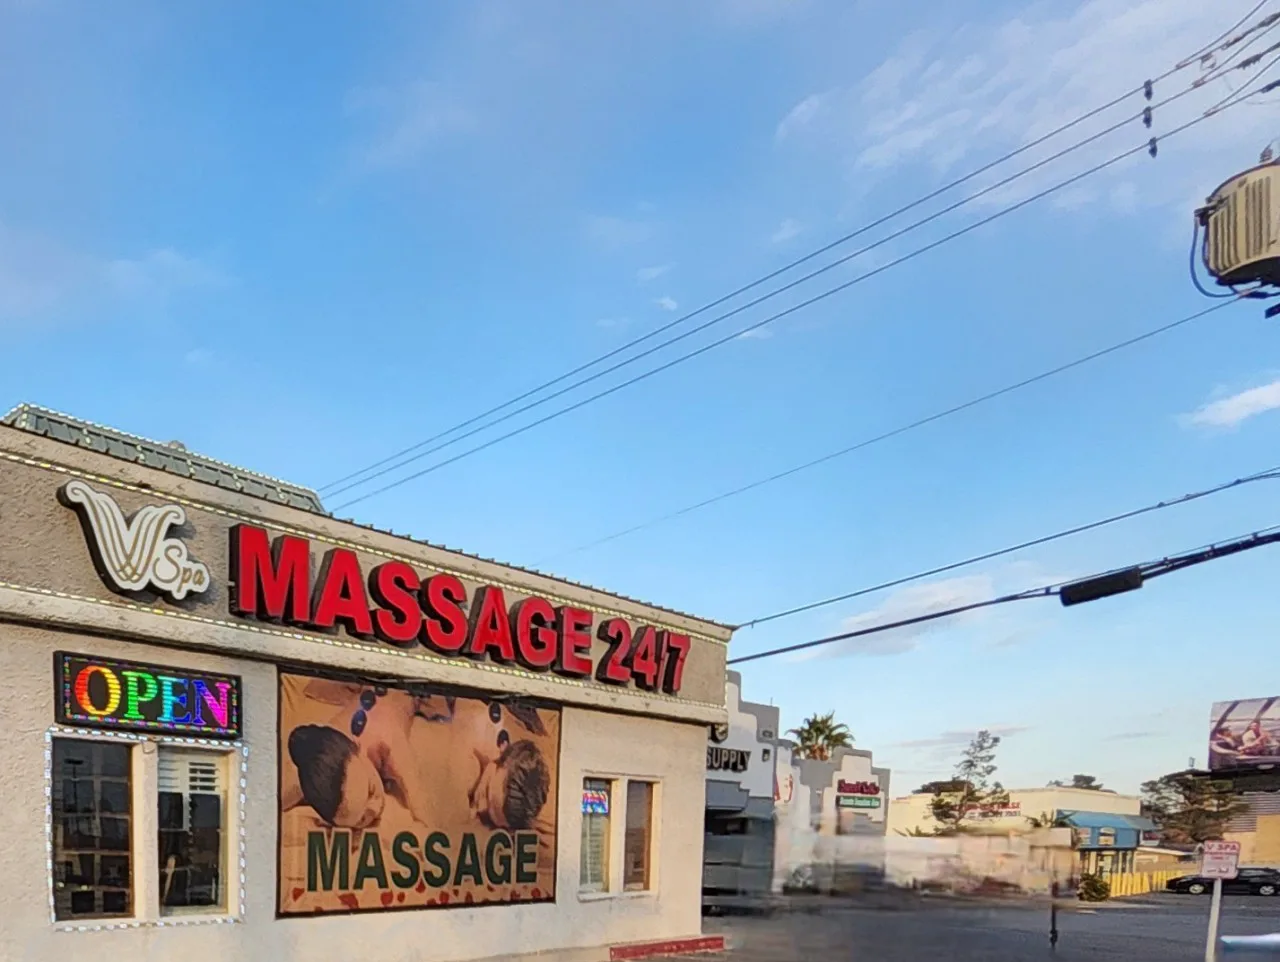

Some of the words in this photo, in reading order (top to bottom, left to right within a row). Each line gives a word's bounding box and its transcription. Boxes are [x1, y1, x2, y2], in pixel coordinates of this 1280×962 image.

[235, 523, 593, 677] MASSAGE
[602, 616, 691, 693] 24/7
[74, 665, 232, 728] OPEN
[306, 830, 539, 892] MASSAGE
